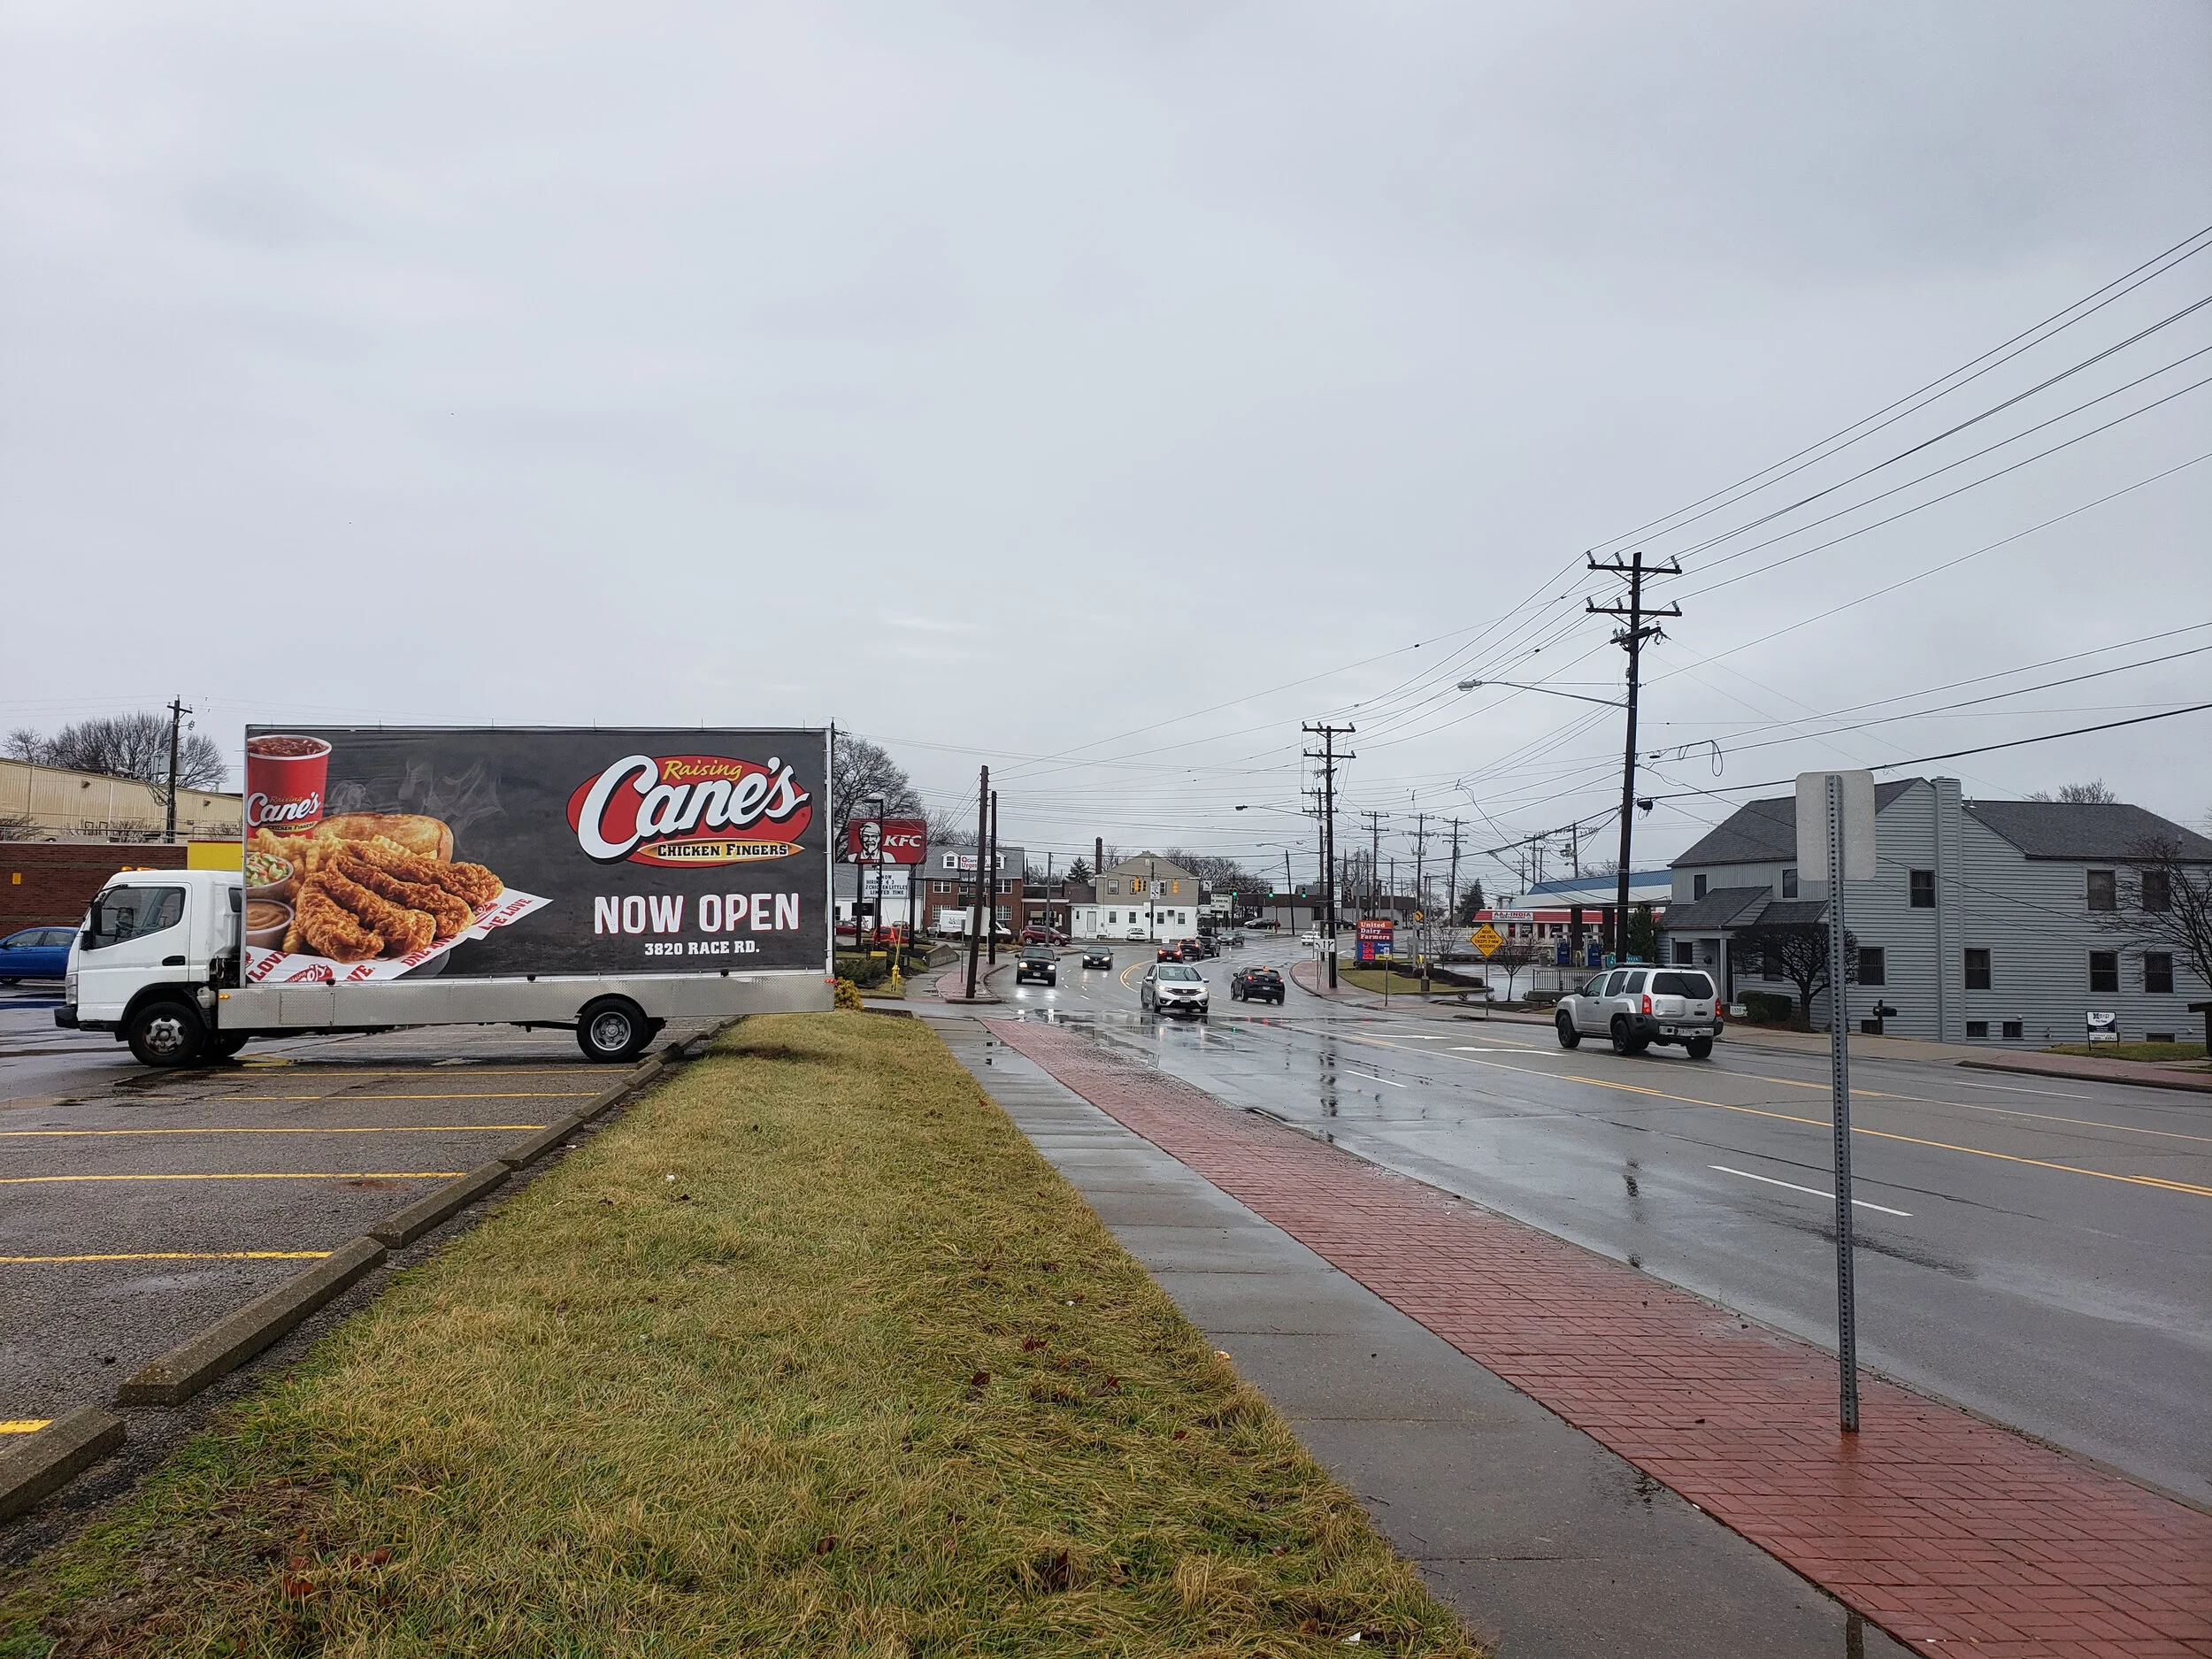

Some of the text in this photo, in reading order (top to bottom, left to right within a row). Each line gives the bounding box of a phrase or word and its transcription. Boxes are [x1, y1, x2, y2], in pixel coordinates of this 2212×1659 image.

[663, 760, 742, 780] Raising
[248, 791, 320, 827] Cane's
[578, 755, 810, 859] Cane's
[657, 843, 787, 857] CHICKEN FINGERS
[883, 834, 922, 847] KFC
[595, 893, 799, 934] NOW OPEN
[644, 941, 760, 956] 3820 RACE RD.
